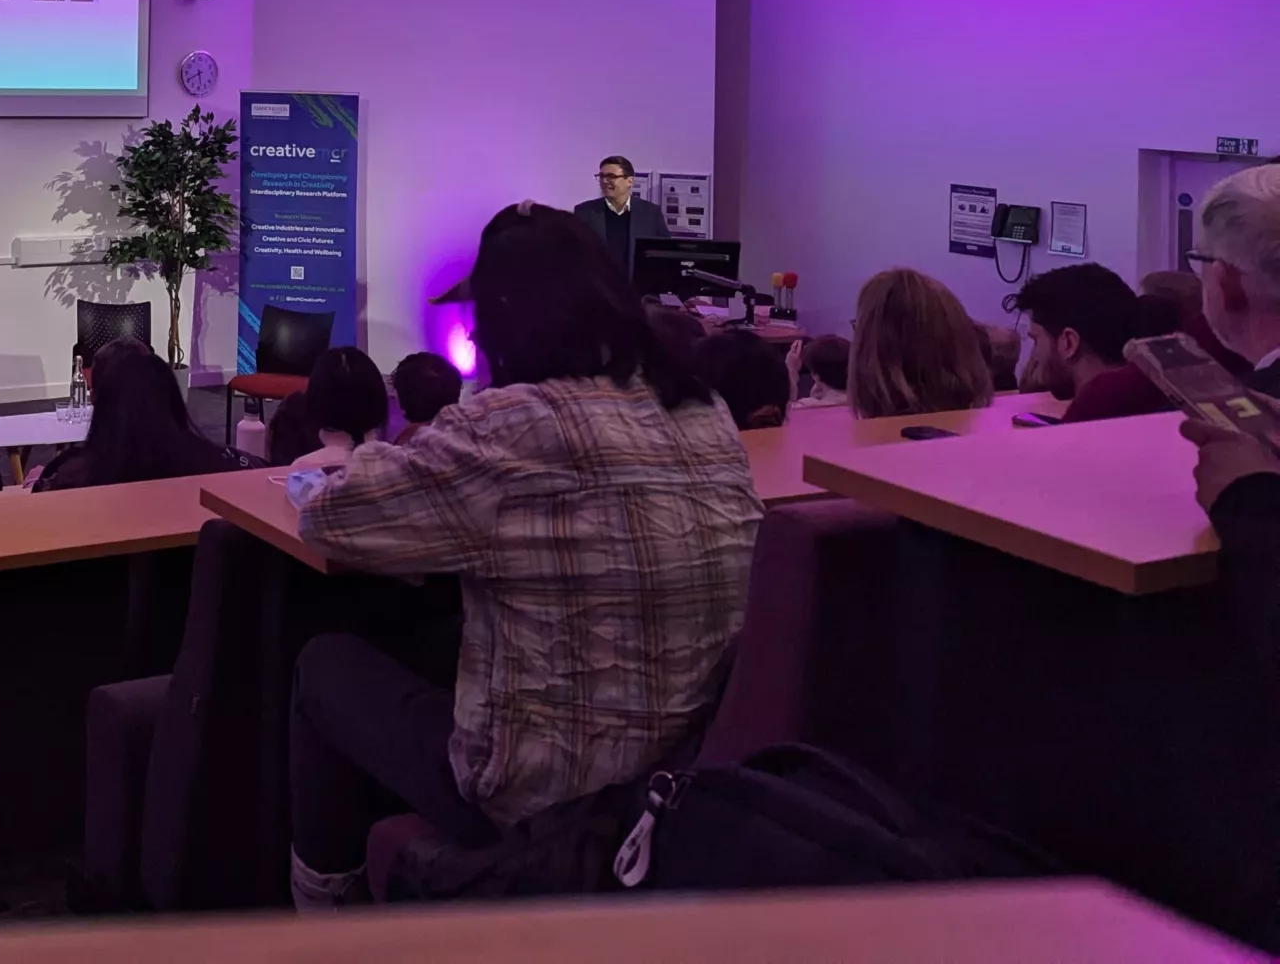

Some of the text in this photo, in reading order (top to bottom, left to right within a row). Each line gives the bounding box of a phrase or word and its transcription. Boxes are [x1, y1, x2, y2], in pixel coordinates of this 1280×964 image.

[1218, 138, 1236, 146] Fire
[251, 170, 288, 180] Developing
[302, 172, 348, 182] Championing
[262, 179, 293, 187] Research
[301, 181, 335, 190] Creativity
[250, 188, 295, 197] Interdisciplinary
[251, 223, 275, 231] Creative
[275, 224, 303, 232] Industries
[297, 236, 312, 244] Civic
[311, 237, 334, 245] Futures
[254, 246, 283, 255] Creativity,
[314, 249, 342, 258] Wellbeing
